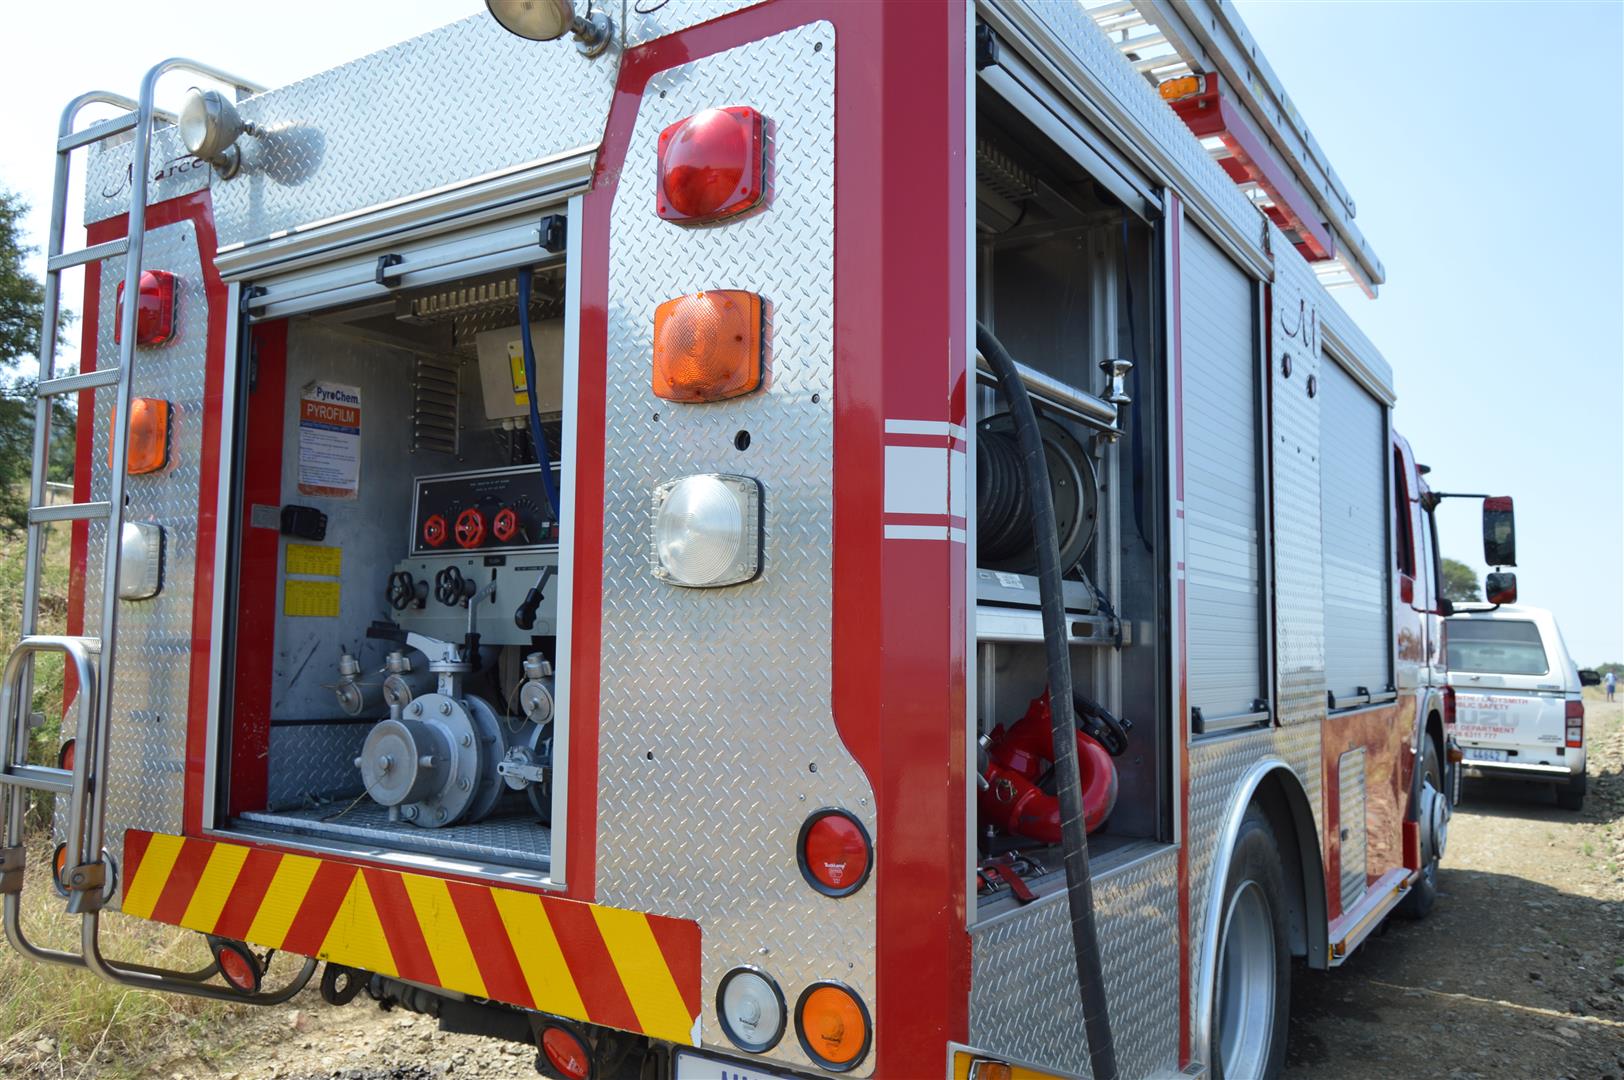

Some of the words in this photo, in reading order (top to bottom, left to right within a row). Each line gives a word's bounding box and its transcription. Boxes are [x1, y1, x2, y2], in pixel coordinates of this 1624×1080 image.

[316, 386, 359, 404] PyroChem
[306, 402, 355, 423] PYROFILM
[1456, 701, 1476, 709] BLIC
[1478, 702, 1509, 711] SAFETY
[1459, 709, 1520, 727] UZU
[1460, 724, 1515, 734] DEPARTMENT
